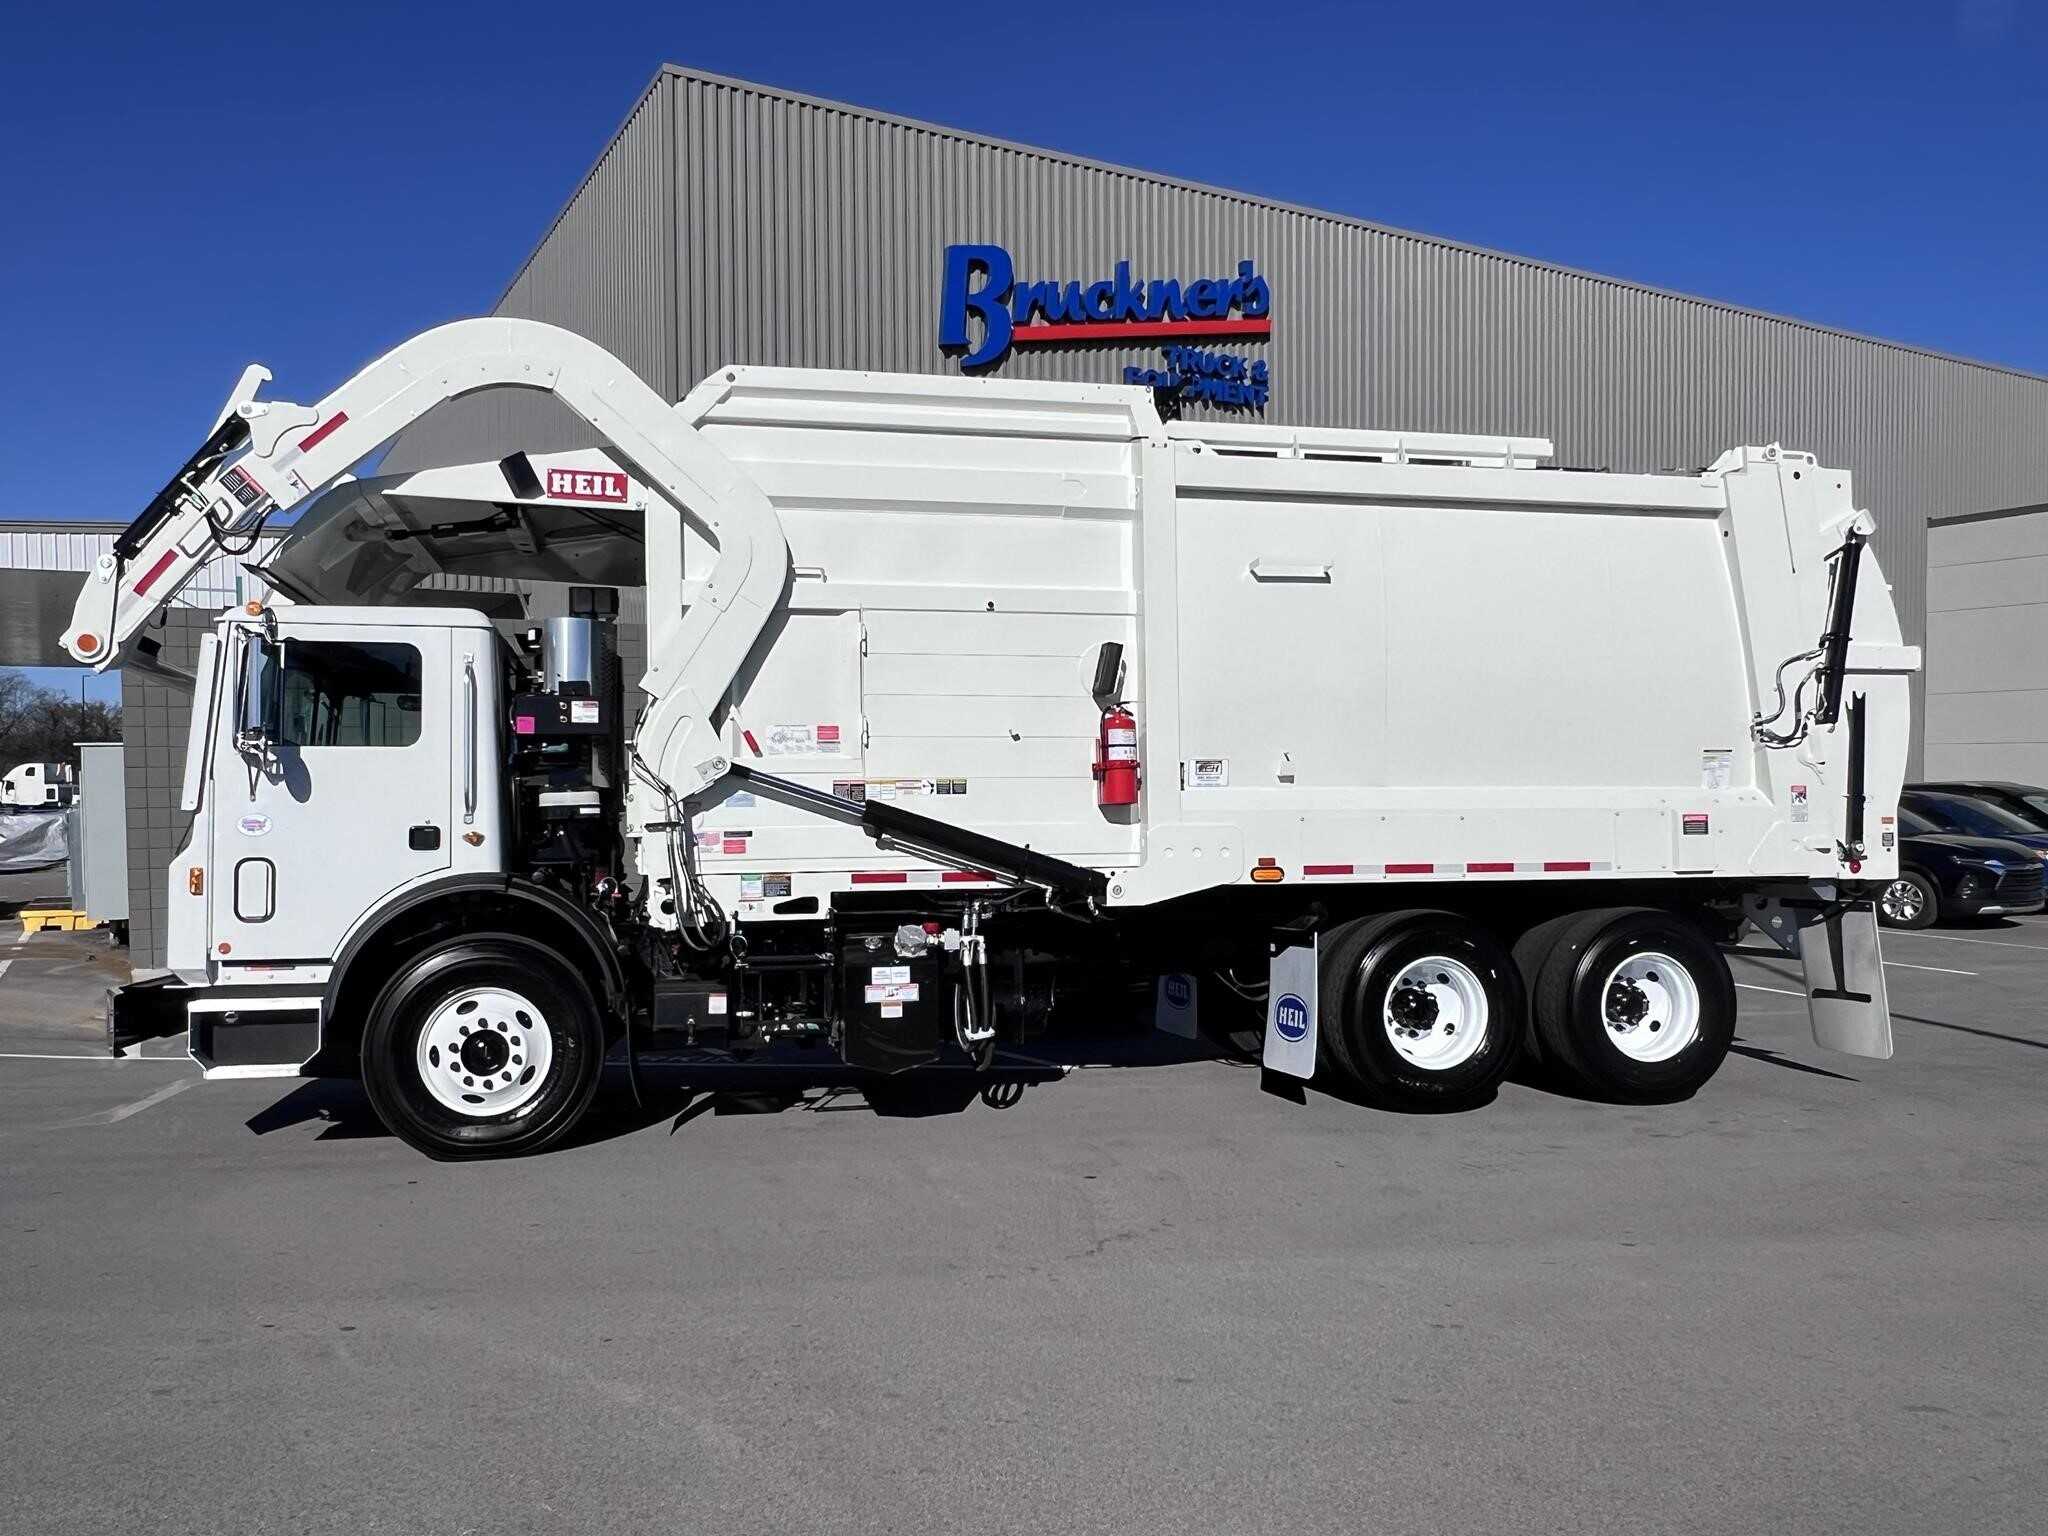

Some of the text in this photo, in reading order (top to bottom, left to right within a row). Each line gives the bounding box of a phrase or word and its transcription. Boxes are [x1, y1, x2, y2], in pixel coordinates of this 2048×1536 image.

[940, 244, 1270, 367] Bruckner's
[1164, 343, 1269, 384] TRUCK &
[551, 473, 622, 497] HEIL
[1279, 1006, 1306, 1029] HEIL
